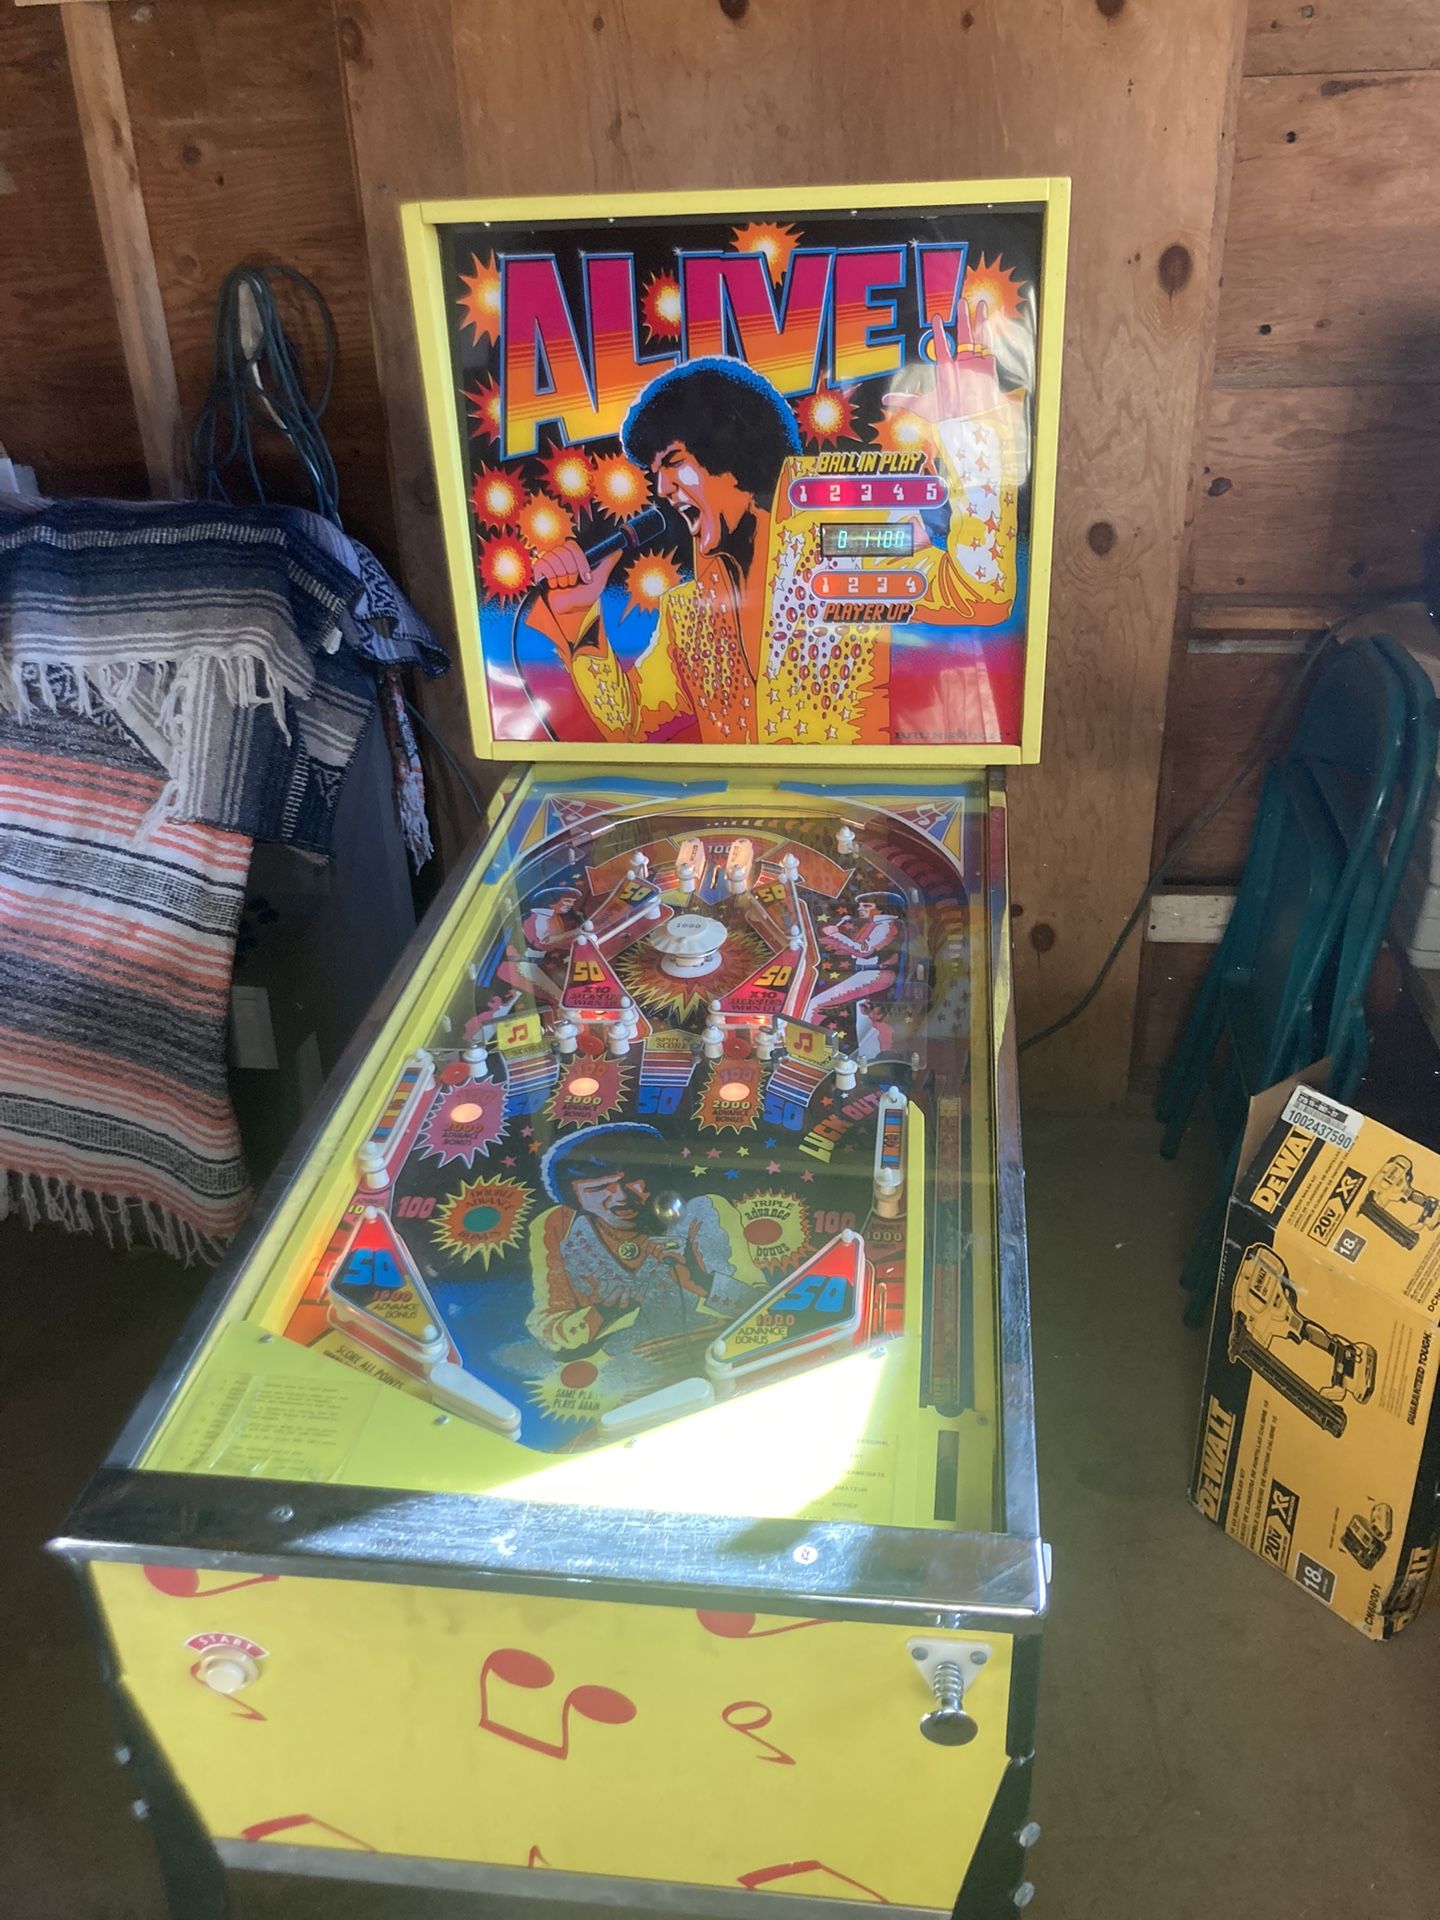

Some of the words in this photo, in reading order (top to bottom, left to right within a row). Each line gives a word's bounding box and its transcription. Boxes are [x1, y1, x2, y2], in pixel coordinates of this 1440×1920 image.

[500, 242, 969, 461] ALIVE!
[816, 452, 858, 474] BALL
[855, 452, 878, 474] IN
[878, 452, 926, 474] PLAY
[800, 486, 808, 502] 1
[829, 485, 841, 502] 2
[861, 484, 872, 502] 3
[893, 484, 904, 501] 4
[926, 483, 937, 500] 5
[821, 577, 830, 593] 1
[848, 577, 859, 593] 2
[877, 577, 888, 593] 3
[905, 577, 916, 593] 4
[823, 603, 886, 623] PLAYER
[887, 603, 913, 623] UP
[619, 881, 651, 901] 50
[757, 884, 787, 903] 50
[572, 960, 606, 982] 50
[754, 965, 793, 987] 50
[564, 1096, 602, 1105] 2000
[637, 1086, 684, 1115] 50
[712, 1100, 751, 1109] 2000
[763, 1094, 804, 1131] 50
[799, 1114, 855, 1164] LUCK
[1288, 1110, 1353, 1149] 1002437590
[1251, 1126, 1315, 1213] DEWA
[396, 1196, 437, 1219] 100
[751, 1199, 796, 1211] TRIPLE
[813, 1210, 857, 1233] 100
[1339, 1238, 1356, 1255] 18
[341, 1247, 405, 1288] 50
[769, 1275, 848, 1313] 50
[737, 1327, 786, 1336] ADVANCE
[1407, 1366, 1426, 1425] GUARANTEED
[1199, 1395, 1234, 1521] DEWALT
[1271, 1489, 1290, 1520] XR
[1303, 1565, 1322, 1591] 18
[198, 1635, 253, 1650] START
